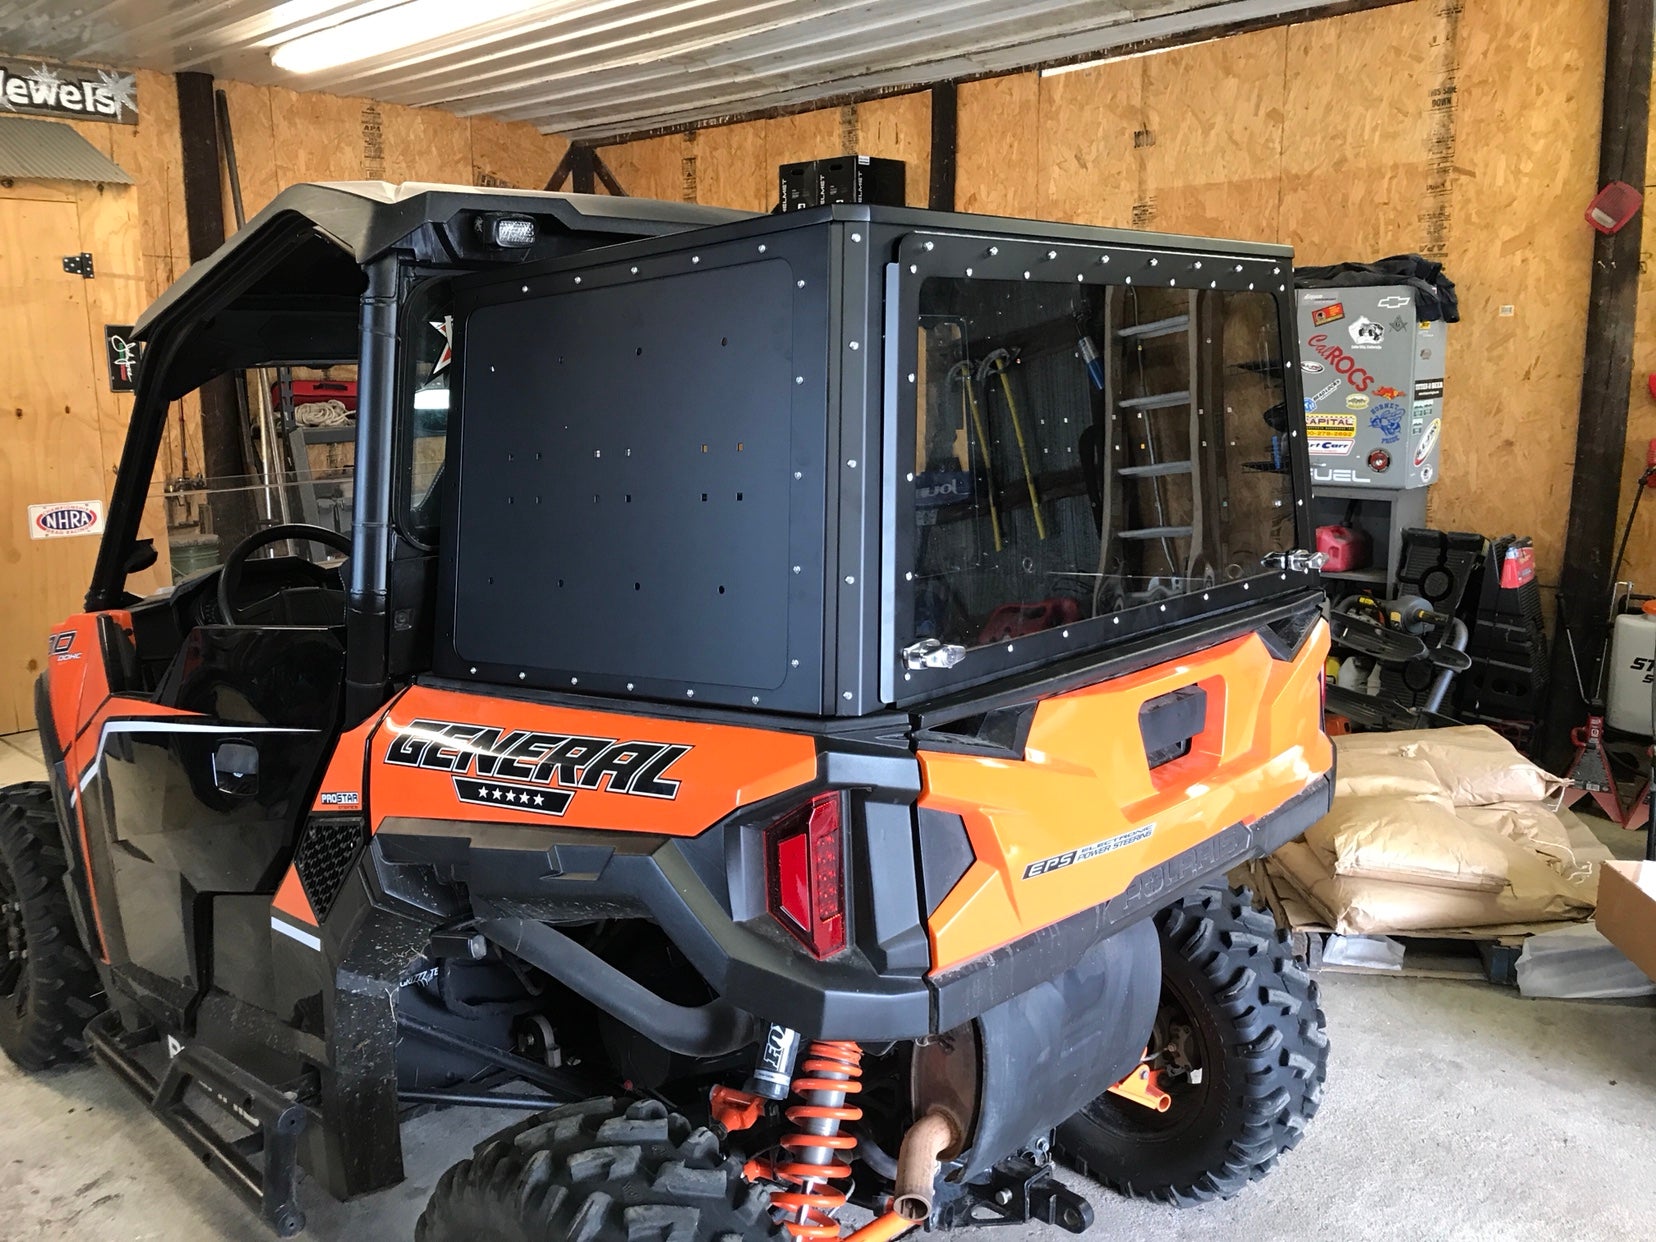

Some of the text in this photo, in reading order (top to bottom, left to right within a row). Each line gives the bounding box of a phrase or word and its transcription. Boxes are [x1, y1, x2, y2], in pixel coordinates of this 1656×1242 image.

[1307, 333, 1375, 392] CalROCS
[1370, 403, 1400, 414] HORNET
[45, 510, 90, 529] NHRA
[384, 718, 696, 800] GENERAL
[321, 792, 359, 804] PROSTAR
[1077, 829, 1153, 861] POWER STEERING
[1081, 824, 1153, 853] ELECTRONIC
[1028, 850, 1074, 878] EPS
